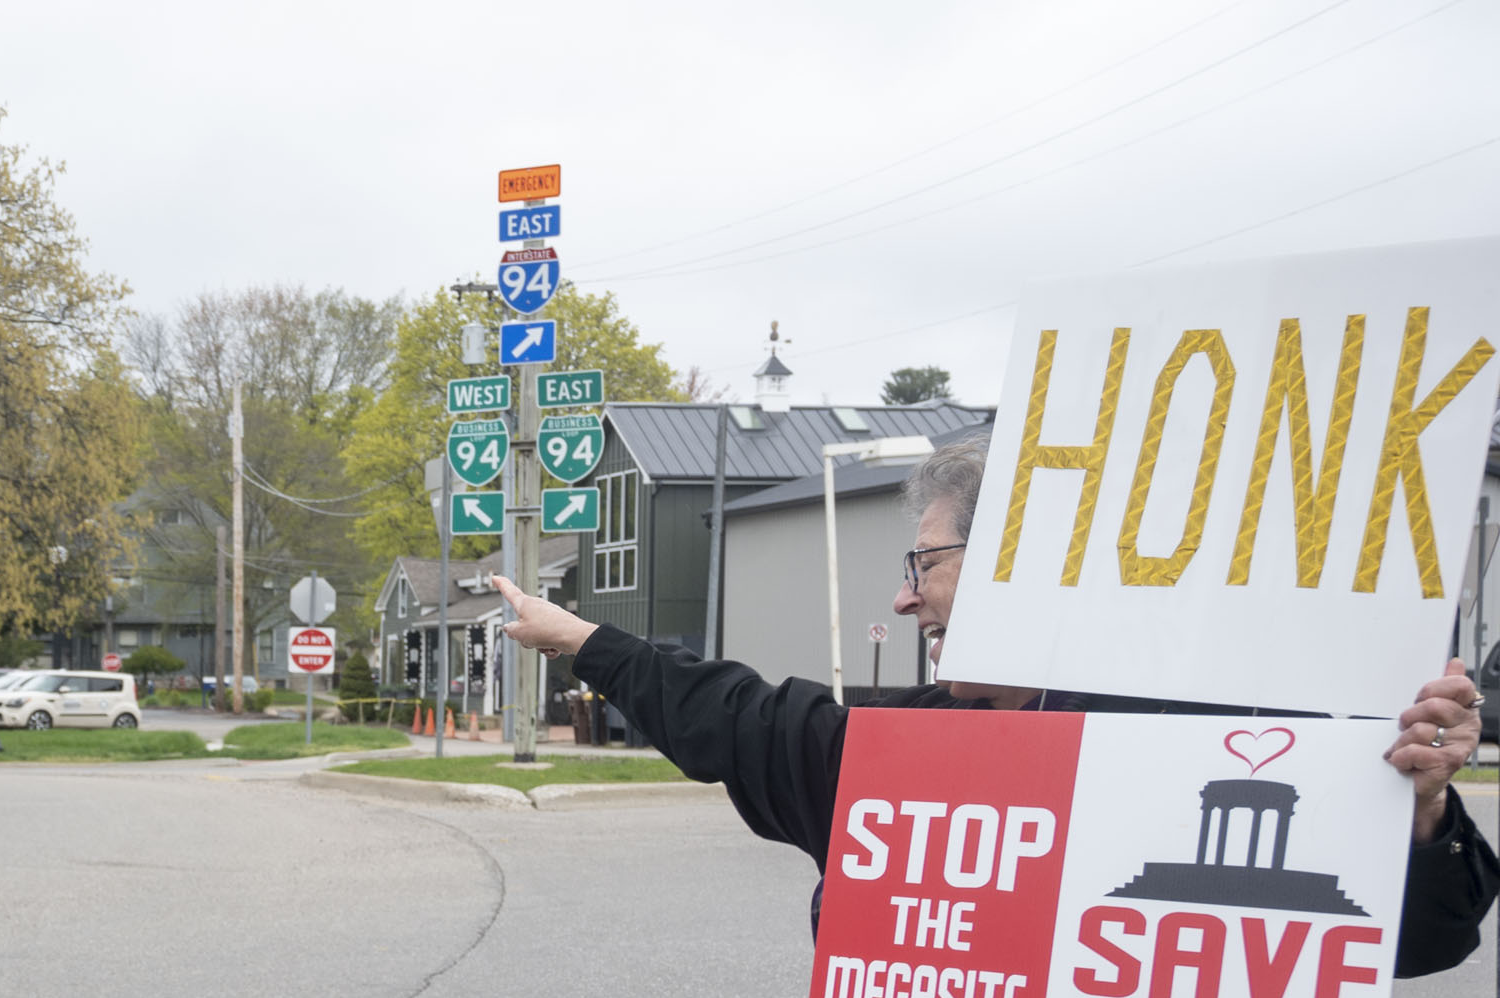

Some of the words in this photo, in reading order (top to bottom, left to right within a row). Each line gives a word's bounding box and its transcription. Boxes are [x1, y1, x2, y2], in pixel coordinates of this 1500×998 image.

[503, 174, 556, 193] EMERGENCY
[507, 213, 552, 236] EAST
[507, 250, 551, 261] INTERSTATE
[502, 263, 551, 301] 94
[454, 385, 504, 407] WEST
[546, 379, 593, 402] EAST
[457, 423, 499, 433] BUSINESS
[548, 418, 593, 429] BUSINESS
[456, 439, 500, 471] 94
[547, 435, 594, 468] 94
[993, 306, 1496, 599] HONK
[297, 635, 309, 644] DO
[310, 635, 327, 644] NOT
[298, 656, 325, 665] ENTER
[841, 798, 1057, 892] STOP
[890, 896, 976, 952] THE
